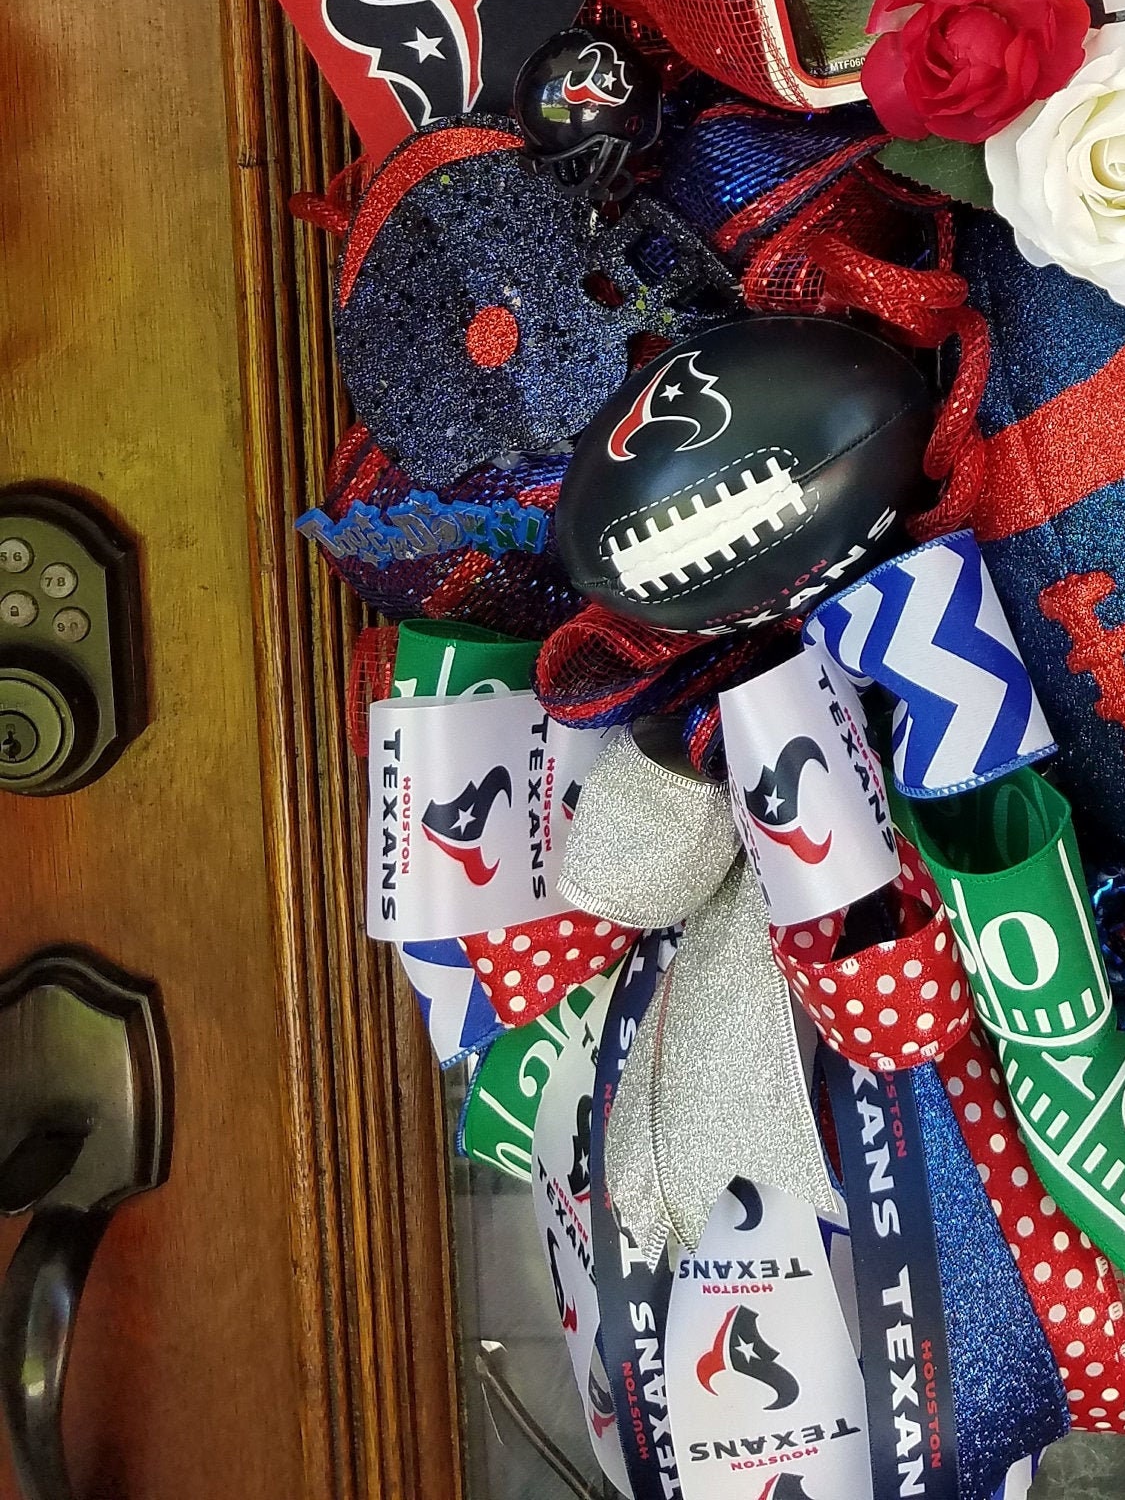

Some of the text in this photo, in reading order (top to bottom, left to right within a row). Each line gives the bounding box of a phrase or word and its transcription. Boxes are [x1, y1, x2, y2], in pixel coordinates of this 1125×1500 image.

[528, 713, 551, 900] TEXANS
[543, 756, 556, 853] HOUSTON
[818, 664, 897, 853] TEXANS
[382, 727, 402, 922] TEXANS
[401, 776, 411, 875] HOUSTON
[553, 1177, 589, 1244] HOUSTON
[679, 1257, 813, 1279] TEXANS
[702, 1283, 774, 1294] HOUSTON
[622, 1360, 650, 1460] HOUSTON
[882, 1264, 926, 1498] TEXAN
[921, 1338, 942, 1469] HOUSTON
[689, 1417, 861, 1462] TEXANS
[731, 1445, 818, 1471] HOUSTON
